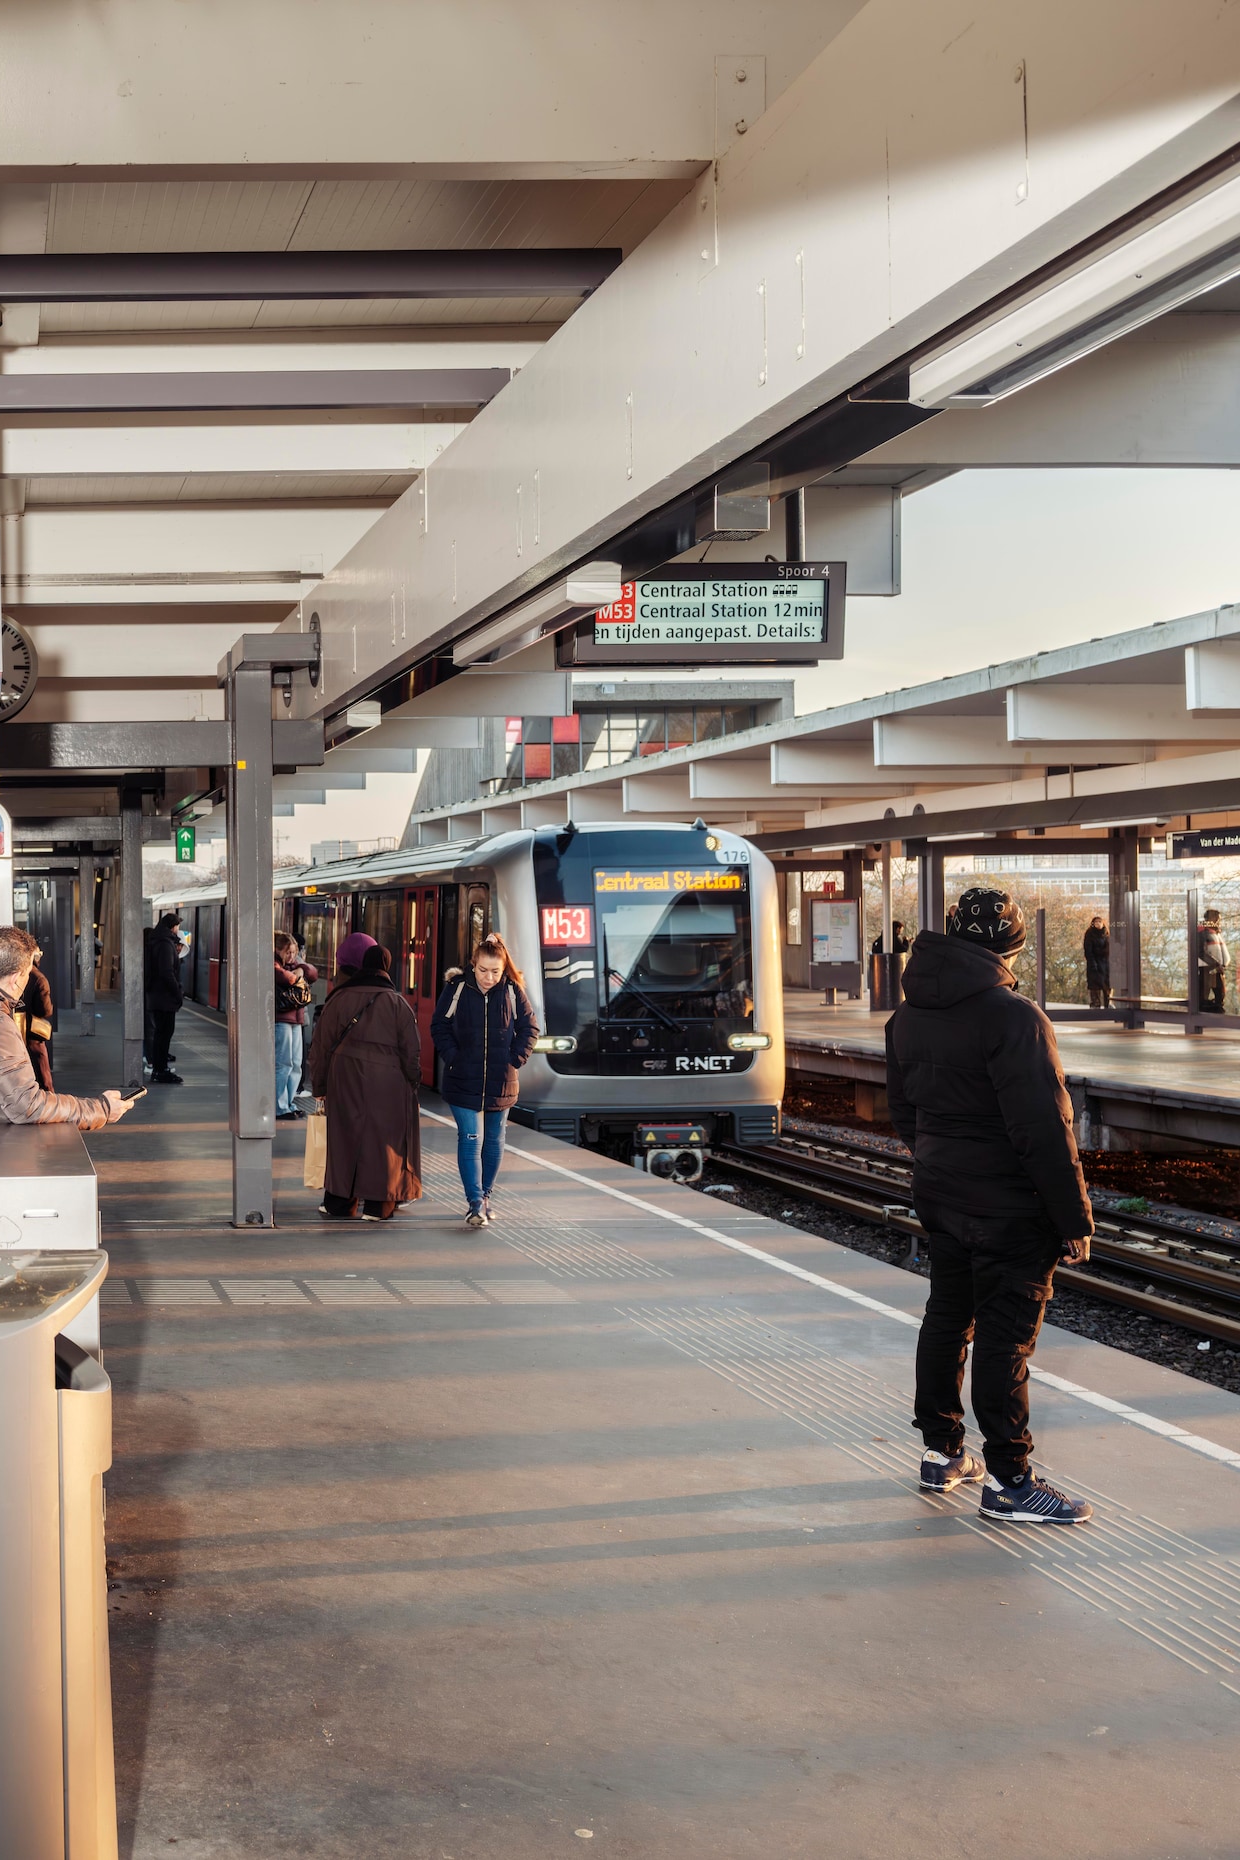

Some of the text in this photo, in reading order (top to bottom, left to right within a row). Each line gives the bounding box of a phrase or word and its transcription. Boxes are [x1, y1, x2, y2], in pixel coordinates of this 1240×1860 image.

[778, 565, 830, 579] Spoor 4
[640, 582, 706, 598] Centraal
[711, 582, 768, 597] Station
[599, 603, 633, 619] M53
[640, 603, 705, 618] Centraal
[711, 602, 767, 617] Station
[615, 624, 660, 643] tijden
[665, 625, 751, 642] aangepast.
[757, 623, 816, 638] Details:
[1200, 838, 1212, 848] Van
[1213, 837, 1224, 847] der
[724, 851, 748, 863] 176
[673, 870, 741, 890] Station
[544, 908, 586, 939] M53
